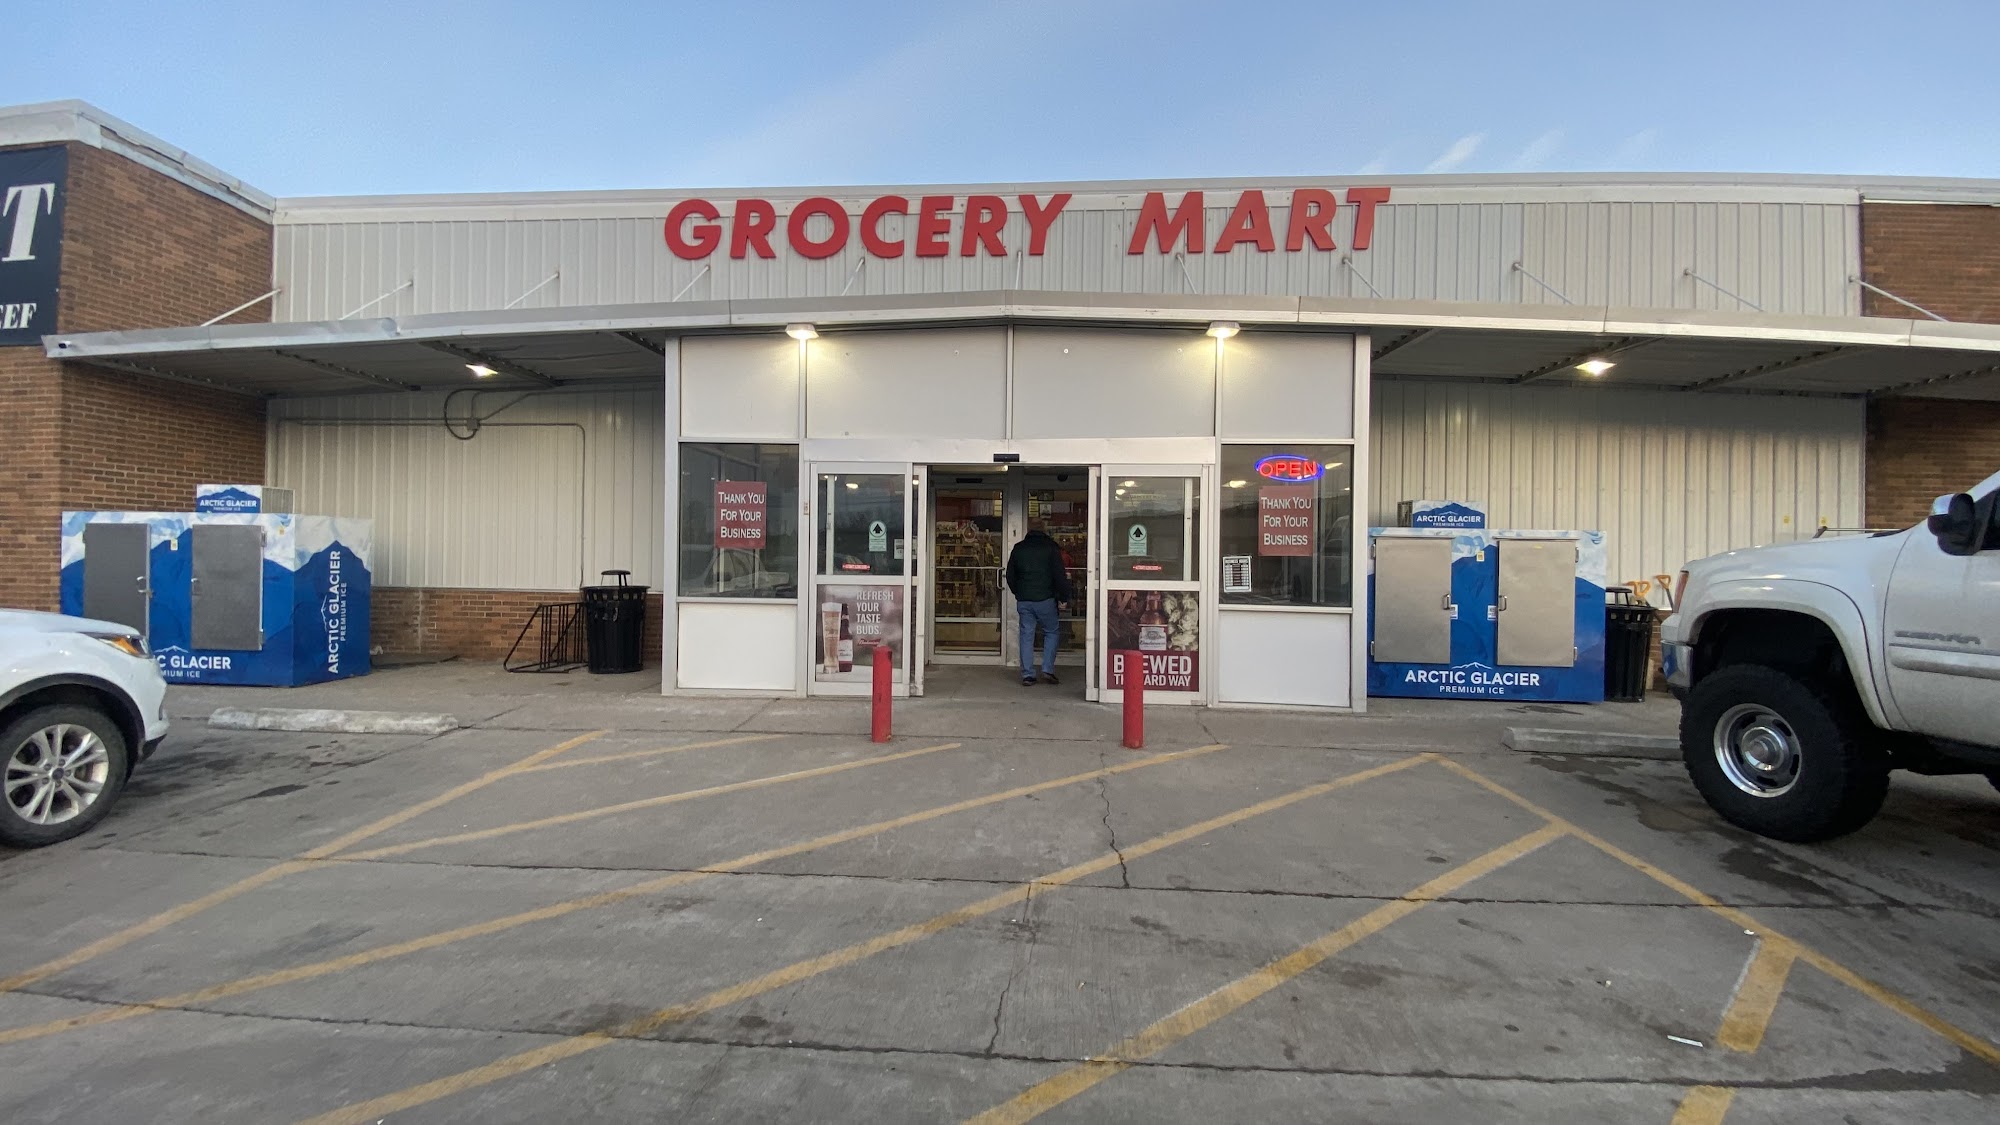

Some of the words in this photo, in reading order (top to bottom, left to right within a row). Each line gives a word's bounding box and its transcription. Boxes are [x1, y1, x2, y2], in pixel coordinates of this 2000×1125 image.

[664, 193, 1073, 260] GROCERY
[1127, 187, 1391, 255] MART
[0, 303, 37, 330] EF
[1259, 461, 1316, 478] OPEN
[226, 500, 257, 508] GLACIER
[329, 550, 341, 614] GLACIER
[856, 590, 894, 600] REFRESH
[856, 602, 879, 612] YOUR
[856, 613, 881, 623] TASTE
[856, 625, 882, 635] BUDS.
[328, 618, 339, 674] ARCTIC
[170, 656, 231, 669] GLACIER
[1113, 654, 1192, 675] BEWED
[186, 670, 200, 678] ICE
[1405, 670, 1466, 684] ARCTIC
[1470, 672, 1540, 686] GLACIER
[1144, 675, 1166, 686] ARD
[1168, 675, 1191, 687] WAY
[1439, 685, 1485, 694] PREMIUM
[1488, 687, 1505, 695] ICE
